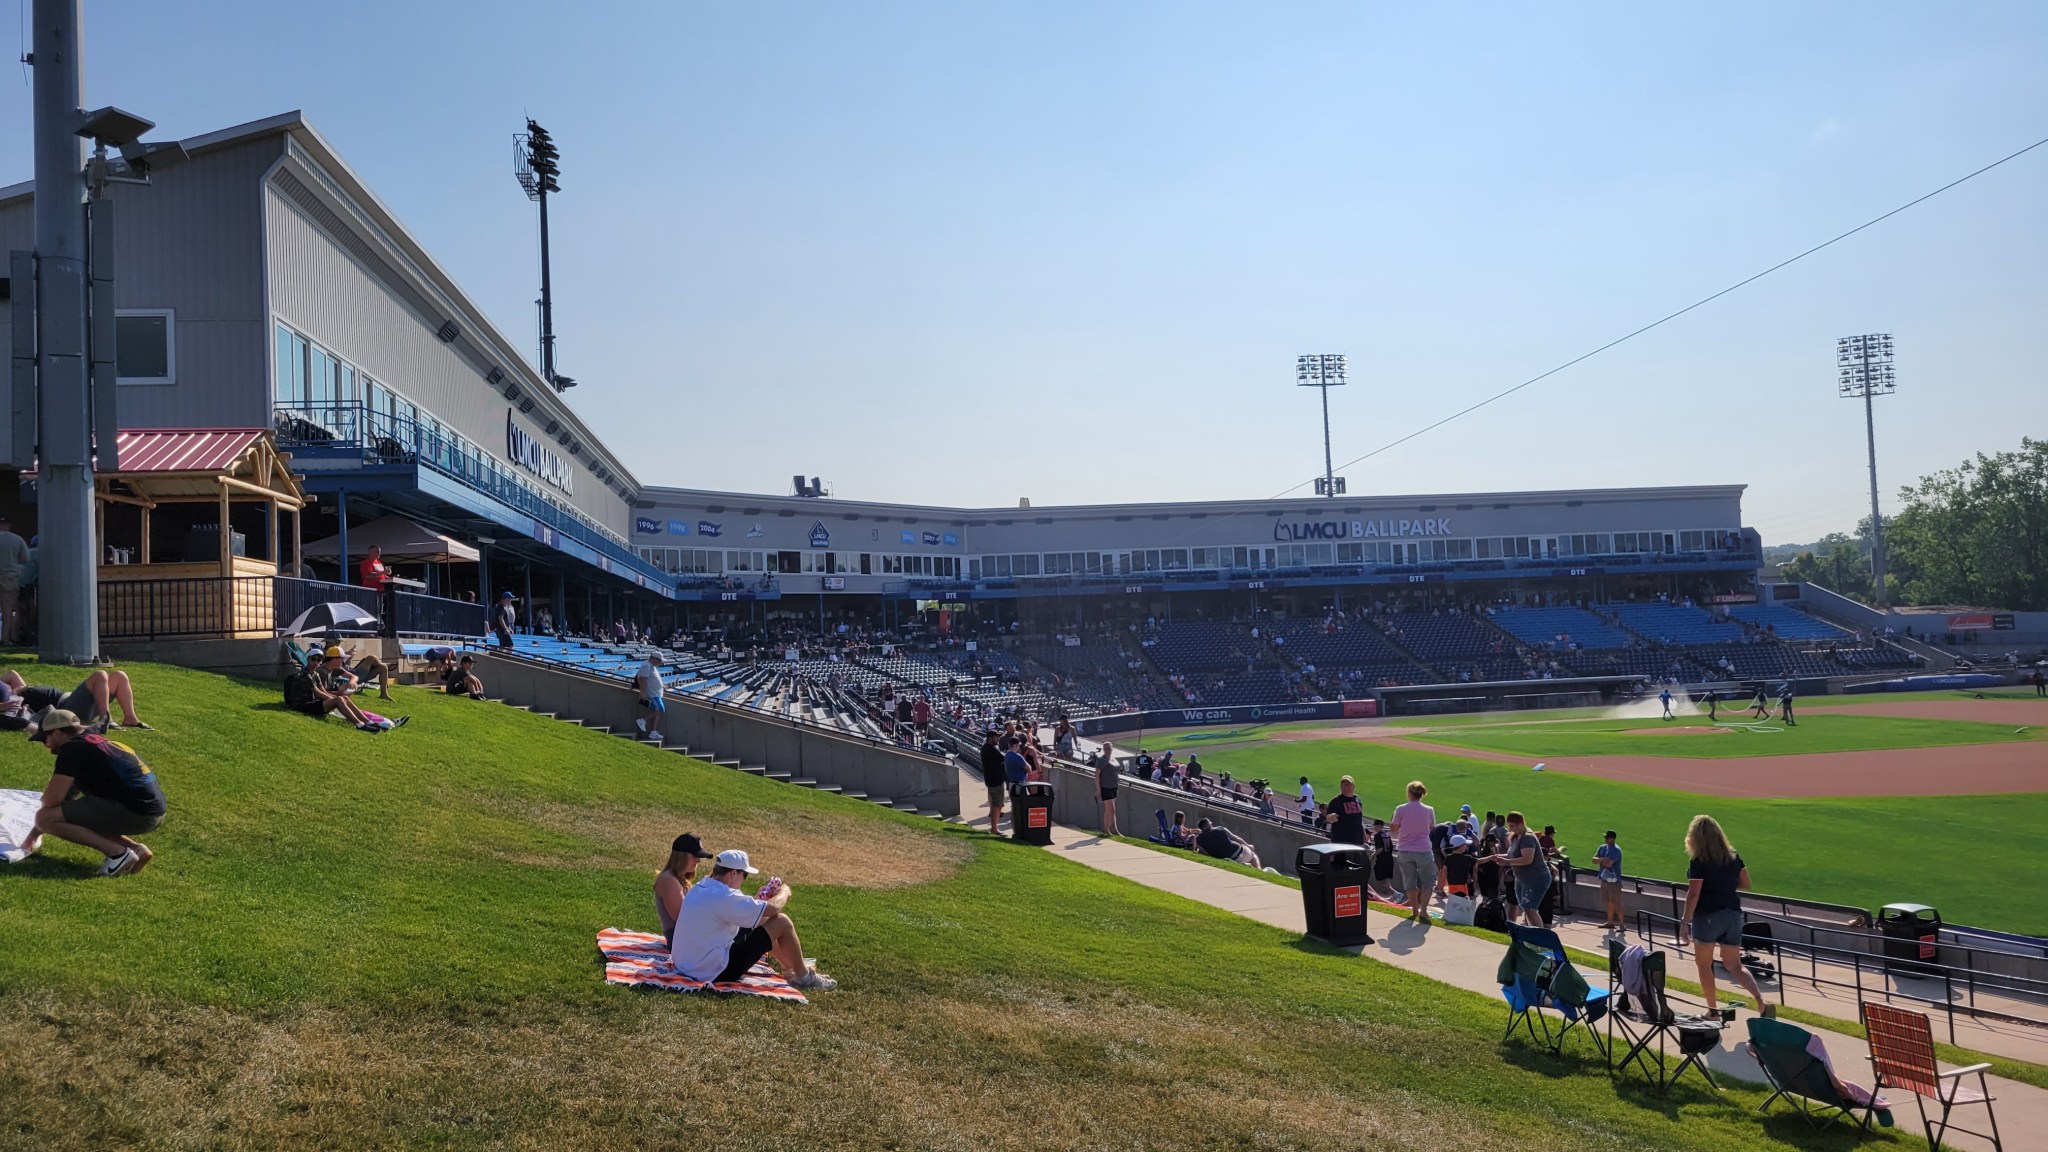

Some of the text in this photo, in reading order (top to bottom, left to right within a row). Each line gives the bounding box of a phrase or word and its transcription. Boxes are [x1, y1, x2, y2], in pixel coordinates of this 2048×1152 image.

[540, 443, 574, 497] BALLPARK
[639, 521, 655, 530] 1996
[699, 524, 715, 534] 2004
[1293, 518, 1452, 539] LMCU BALLPARK
[1248, 581, 1265, 589] DTE
[721, 592, 737, 600] DTE
[1182, 709, 1232, 720] We can.
[1263, 706, 1316, 716] Corewell Health
